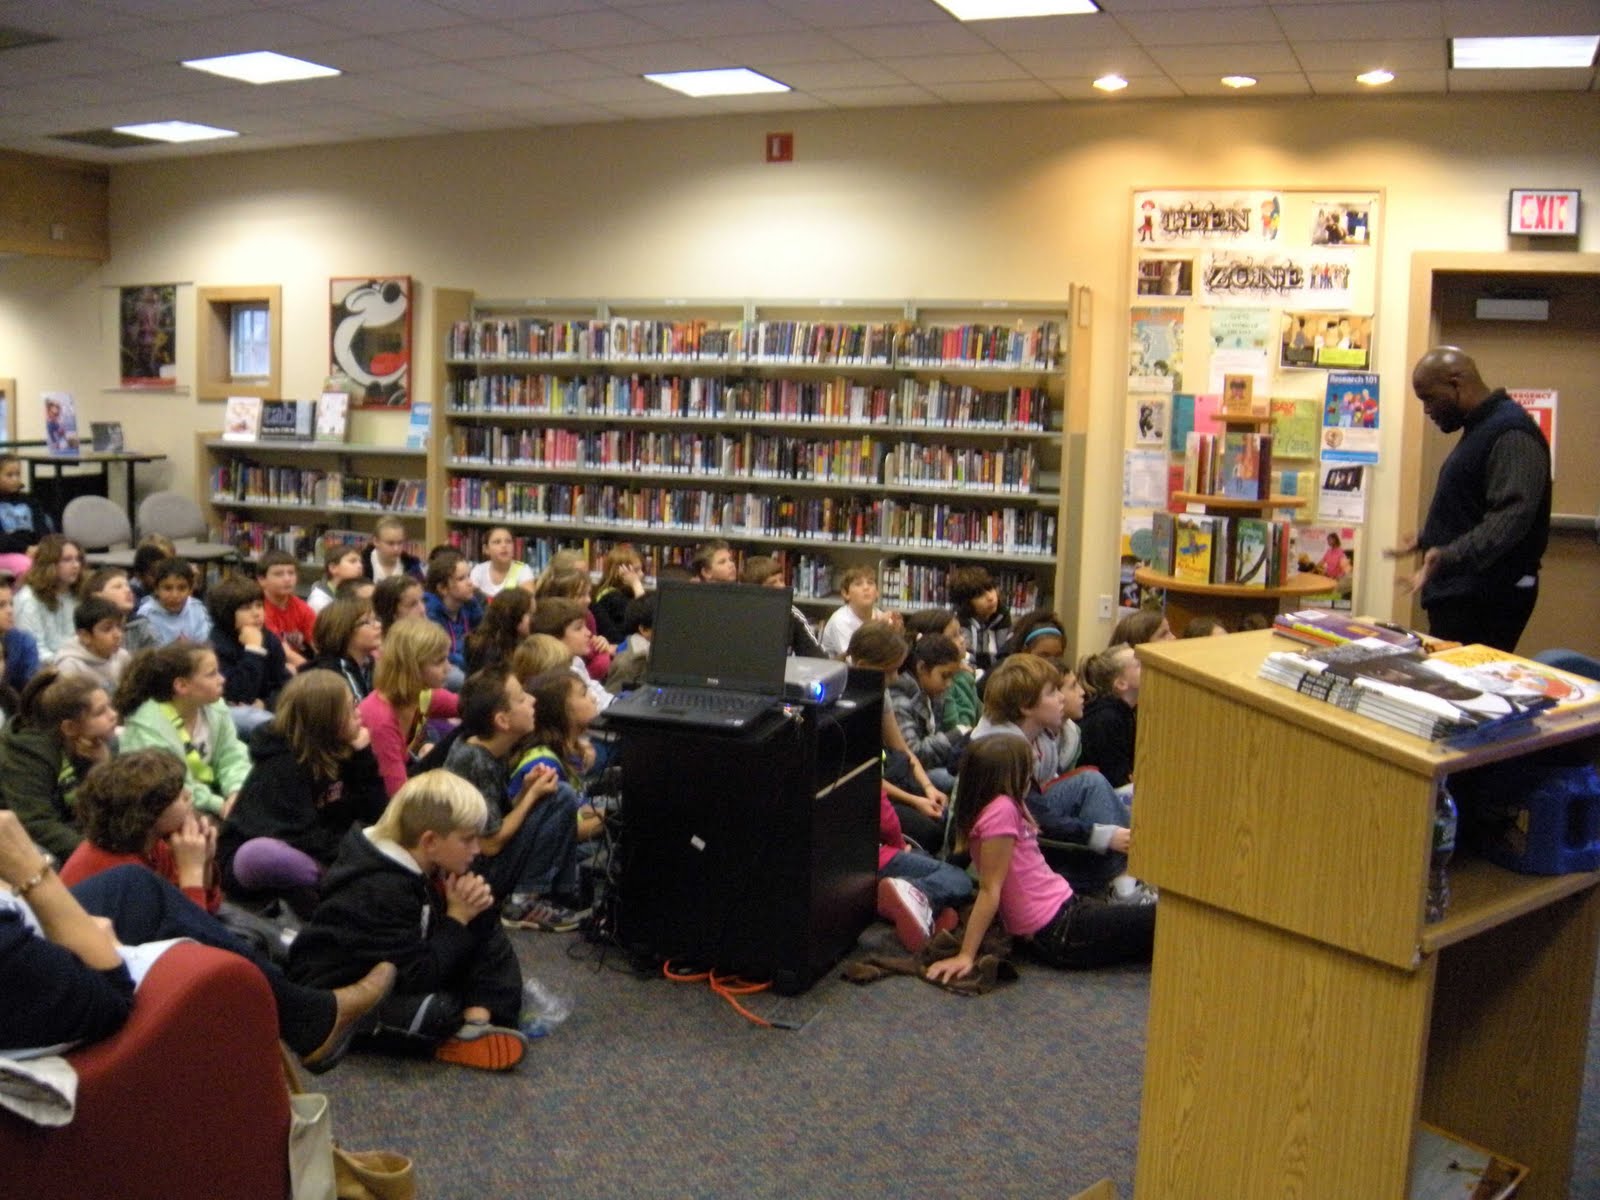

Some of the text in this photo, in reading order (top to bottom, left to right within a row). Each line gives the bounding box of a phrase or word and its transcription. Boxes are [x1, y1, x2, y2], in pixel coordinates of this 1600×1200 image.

[1160, 204, 1251, 234] TEEN
[1520, 195, 1568, 229] EXIT
[1204, 262, 1304, 291] ZONE
[1364, 375, 1378, 385] 101
